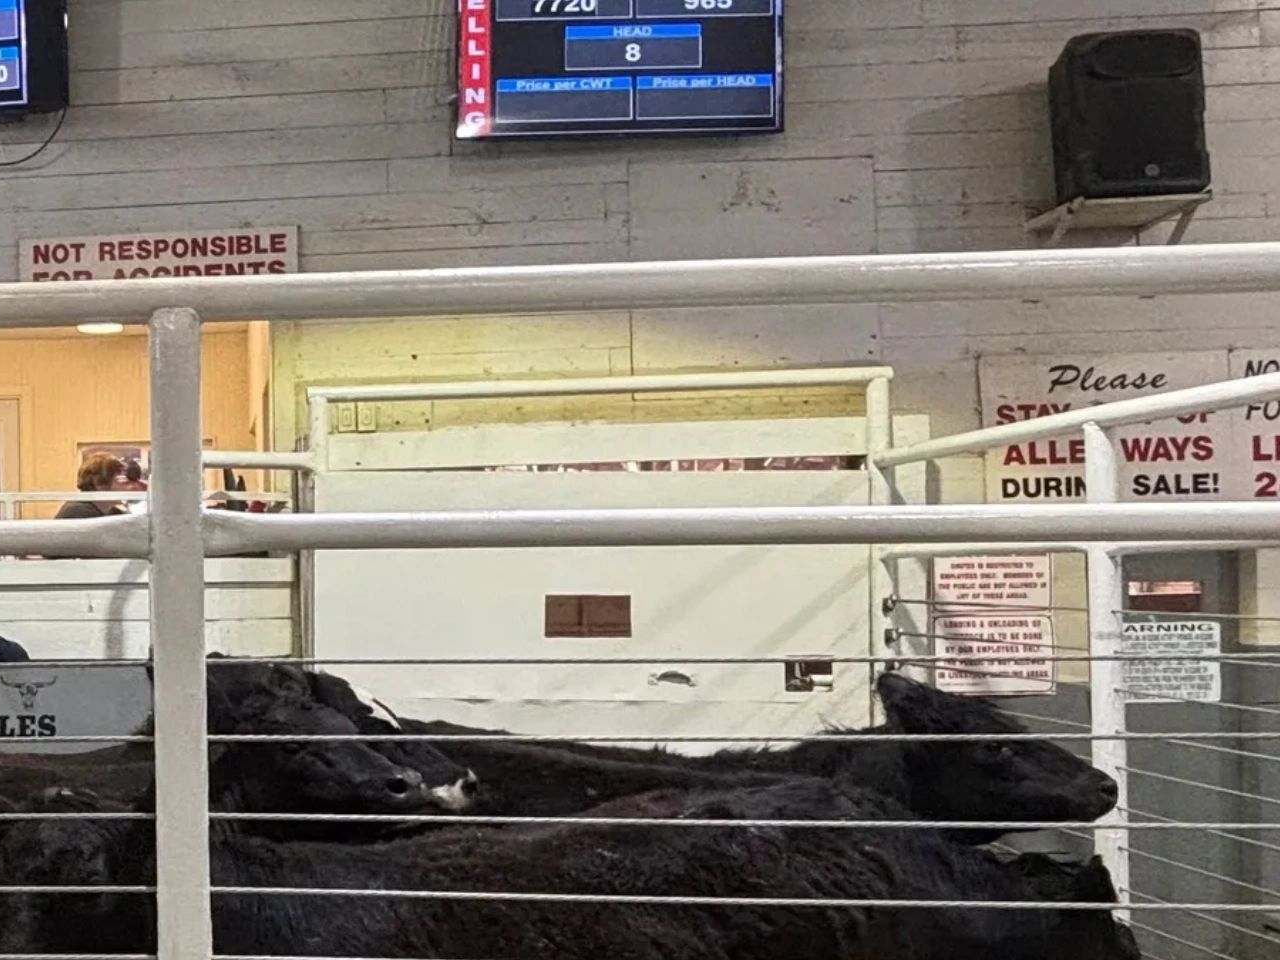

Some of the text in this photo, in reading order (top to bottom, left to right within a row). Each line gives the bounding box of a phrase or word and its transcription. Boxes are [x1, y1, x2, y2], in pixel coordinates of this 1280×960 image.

[534, 0, 596, 13] 7720
[613, 26, 653, 37] HEAD
[625, 43, 641, 62] 8
[465, 0, 486, 127] ELLING
[516, 79, 613, 91] Price per CWT
[652, 75, 757, 89] Price per HEAD
[33, 233, 287, 264] NOT RESPONSIBLE
[1048, 364, 1167, 394] Please
[1001, 473, 1219, 499] DURIN SALE!
[1124, 624, 1214, 634] ARNING
